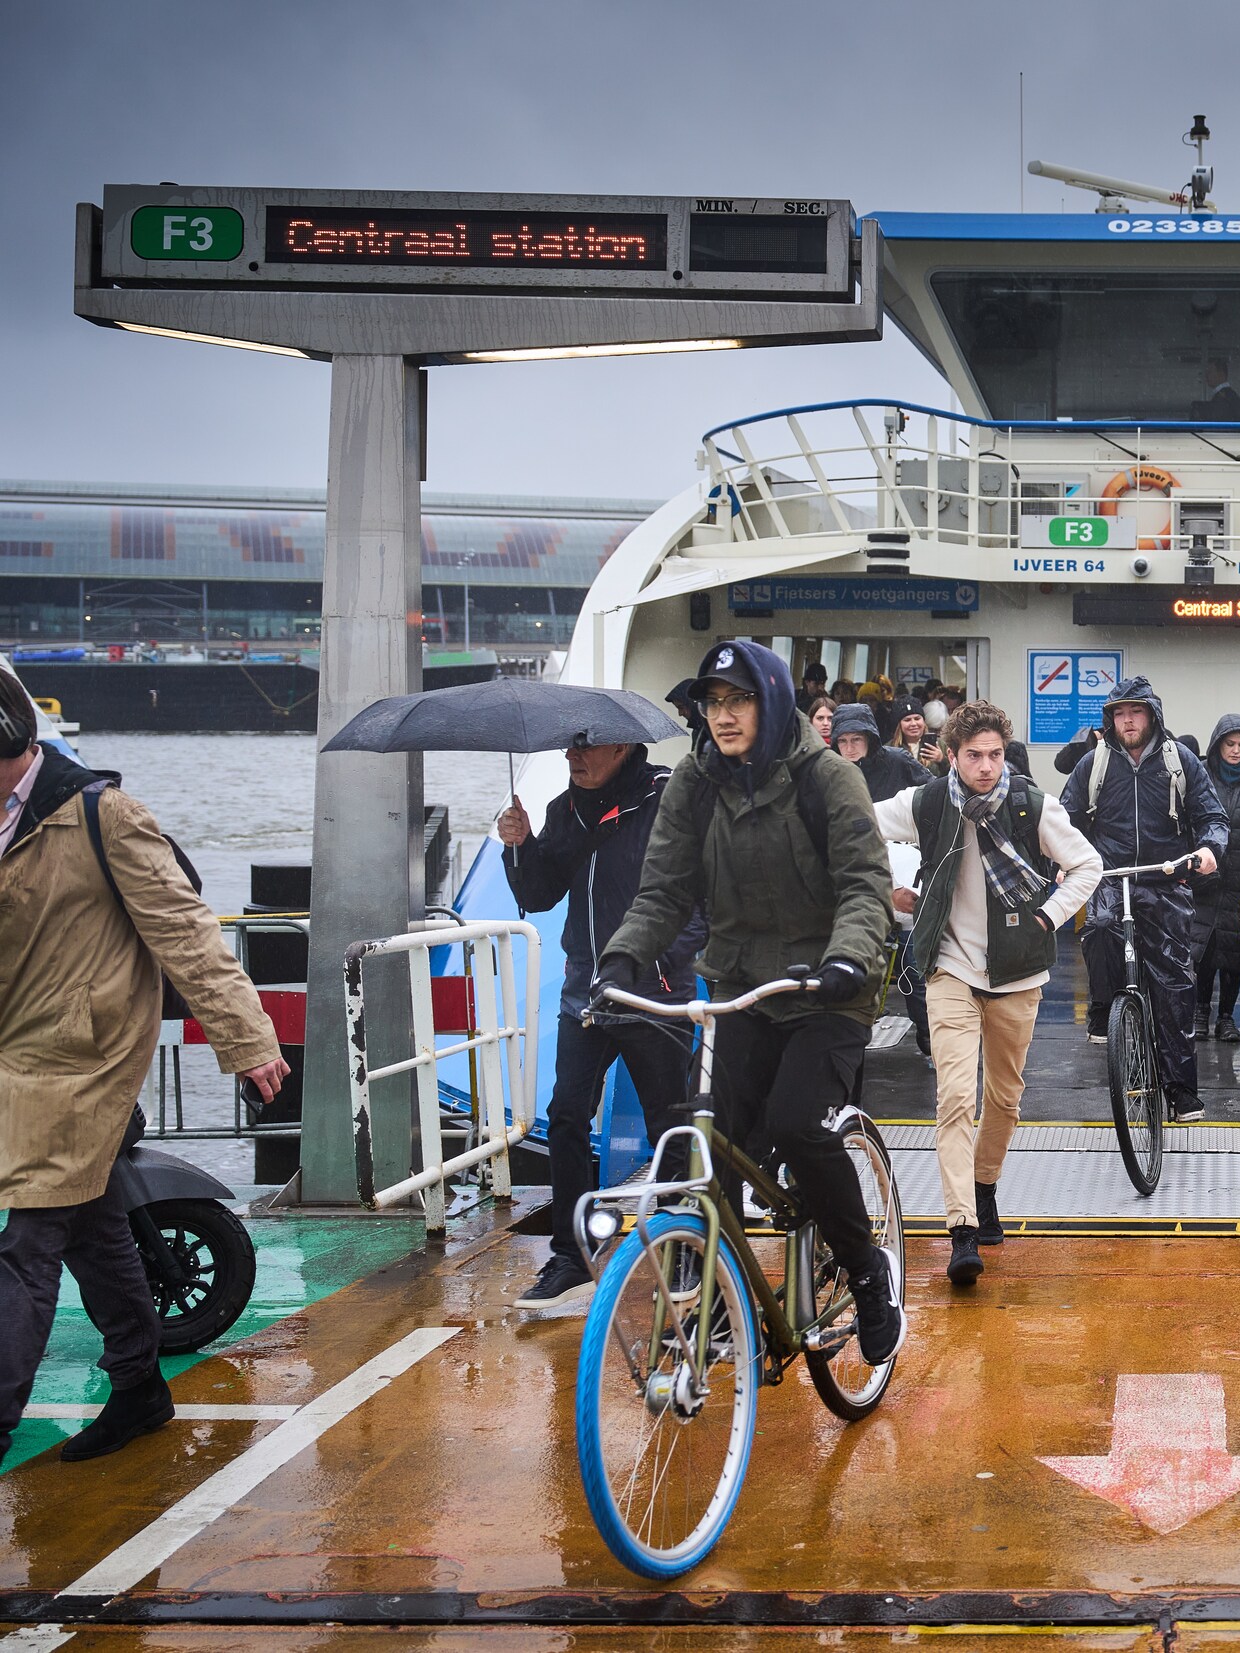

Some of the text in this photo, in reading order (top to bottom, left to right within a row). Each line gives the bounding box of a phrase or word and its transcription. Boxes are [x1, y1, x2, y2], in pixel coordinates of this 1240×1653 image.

[695, 199, 738, 213] MIN.
[783, 201, 826, 215] SEC.
[162, 215, 214, 252] F3
[287, 220, 646, 260] Centraal station
[1064, 521, 1094, 543] F3
[1013, 558, 1106, 573] IJVEER 64
[774, 586, 837, 600] Fietsers
[852, 588, 951, 604] voetgangers
[1173, 600, 1233, 617] Centraal
